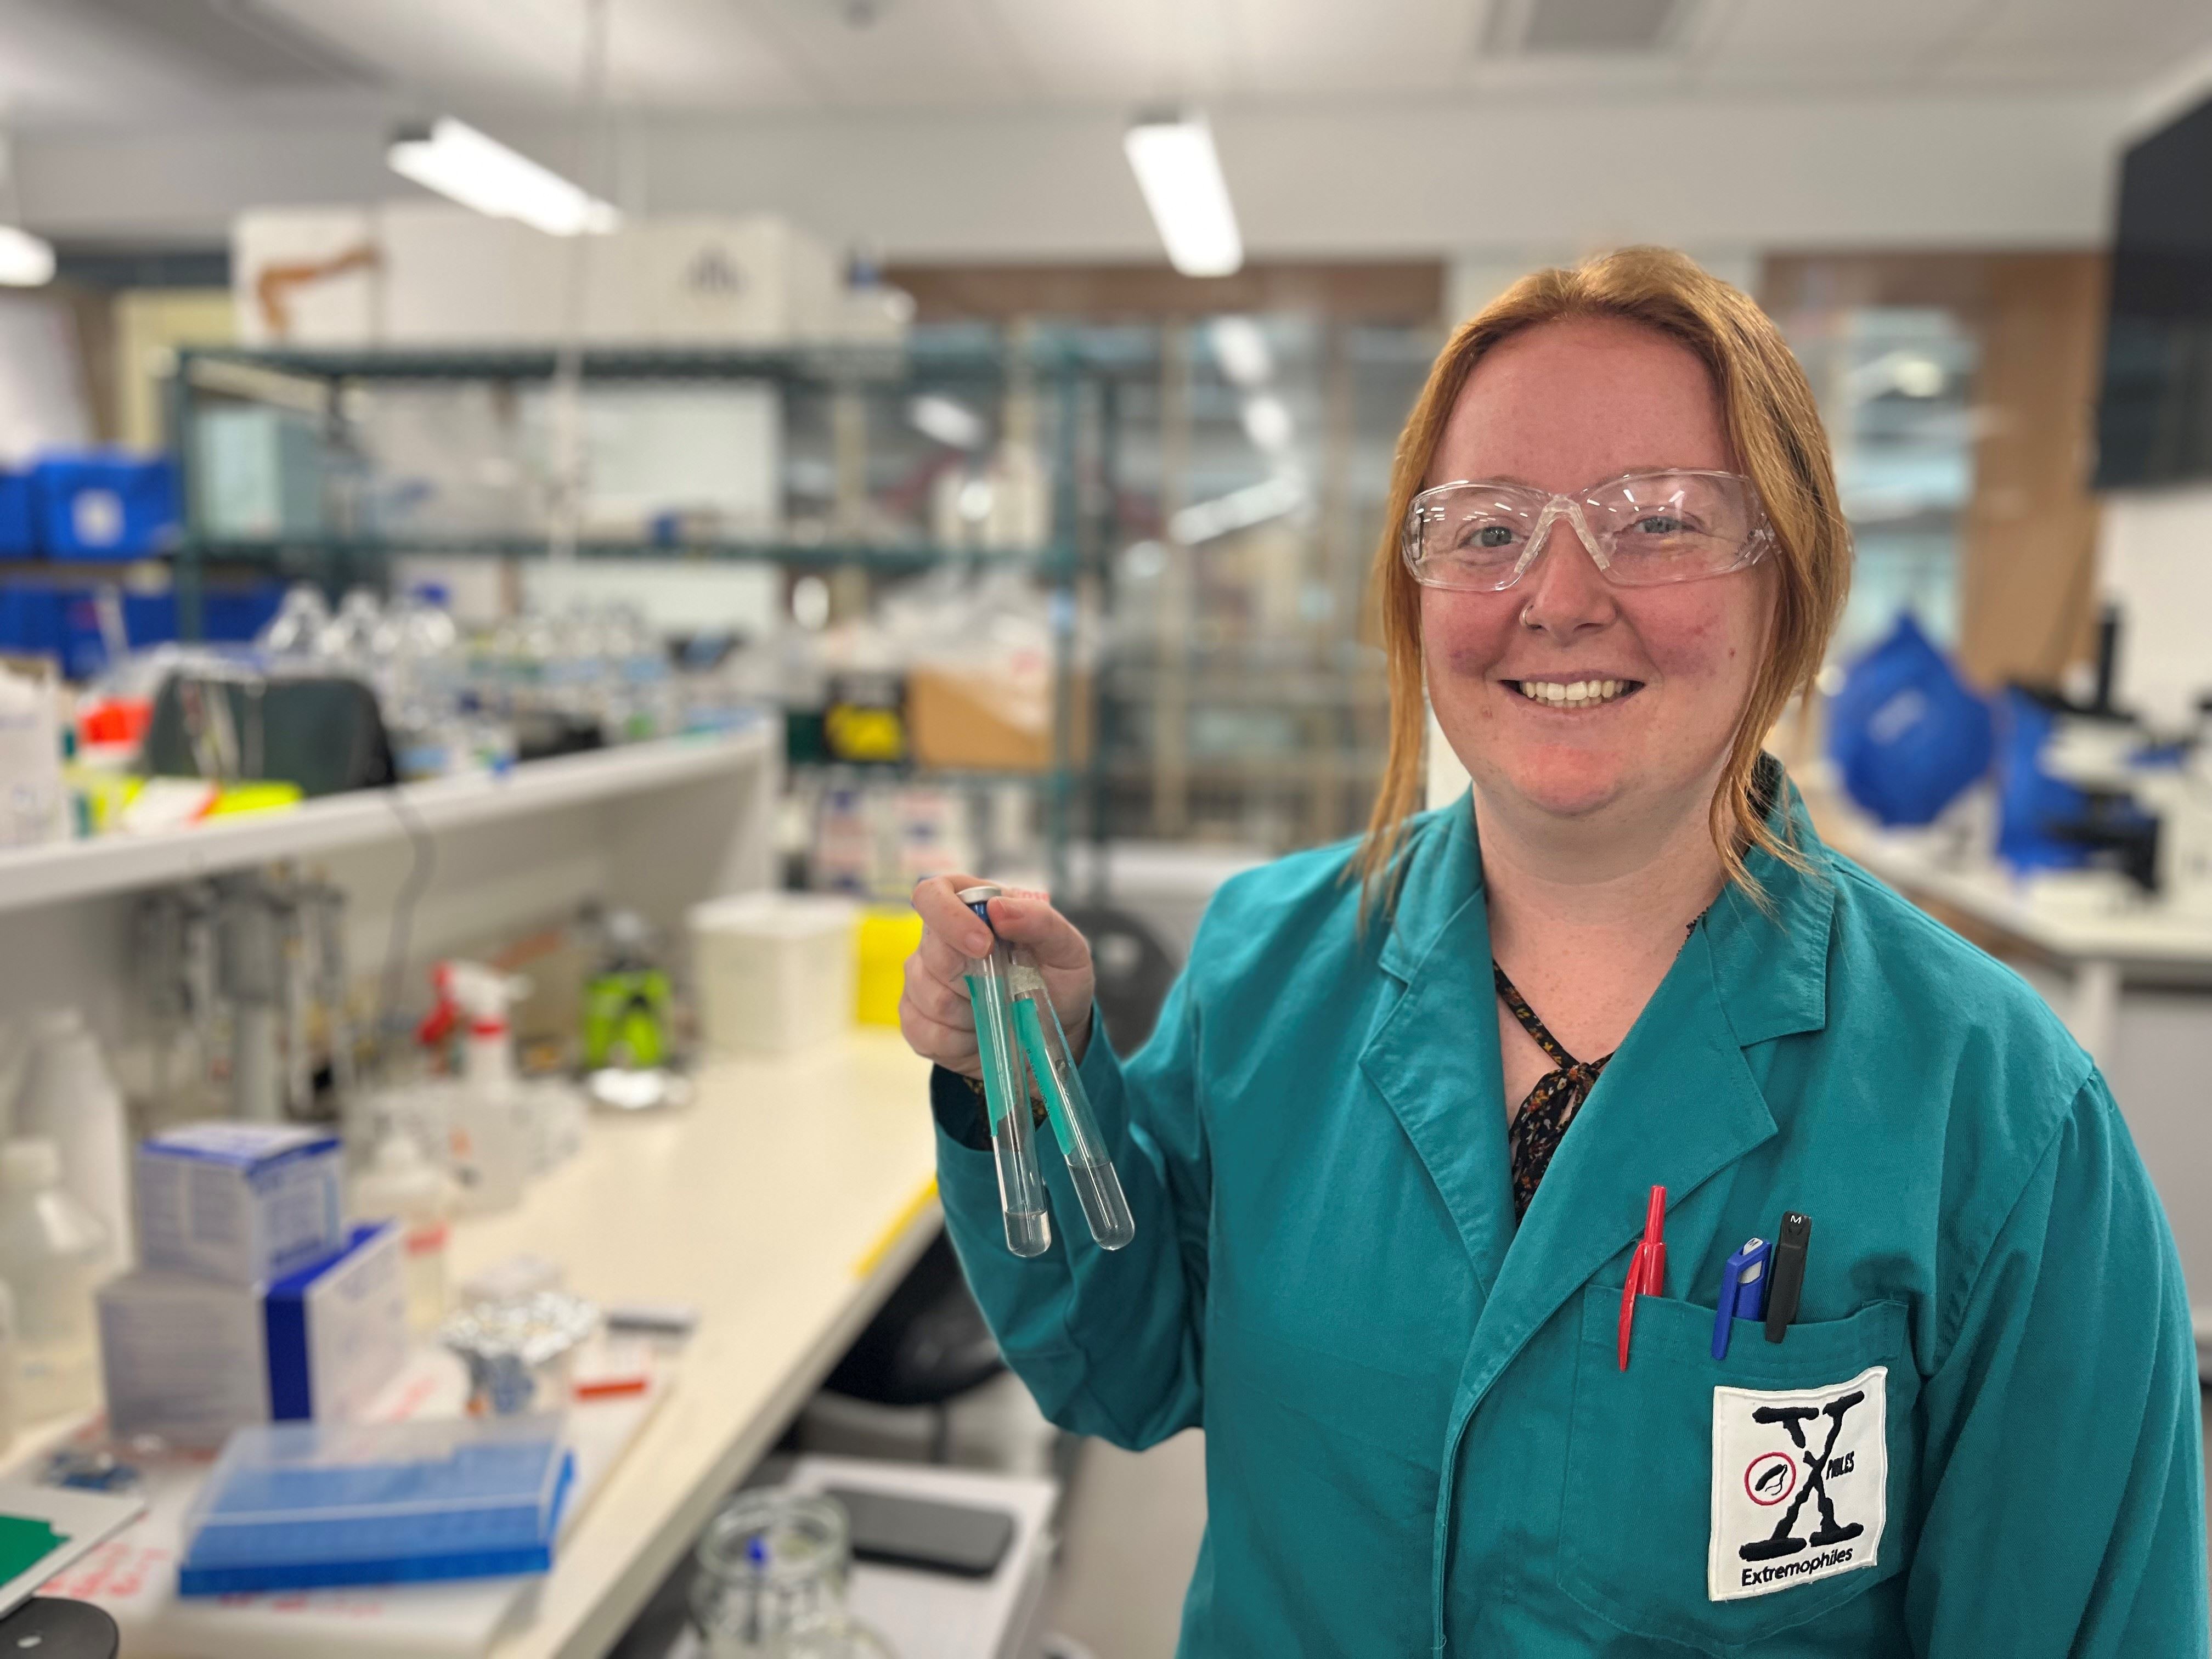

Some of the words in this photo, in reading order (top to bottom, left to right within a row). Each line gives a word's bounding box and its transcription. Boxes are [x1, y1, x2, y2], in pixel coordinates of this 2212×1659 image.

[1790, 1215, 1802, 1224] M
[1748, 1238, 1759, 1247] M
[1742, 1548, 1853, 1587] Extremophiles
